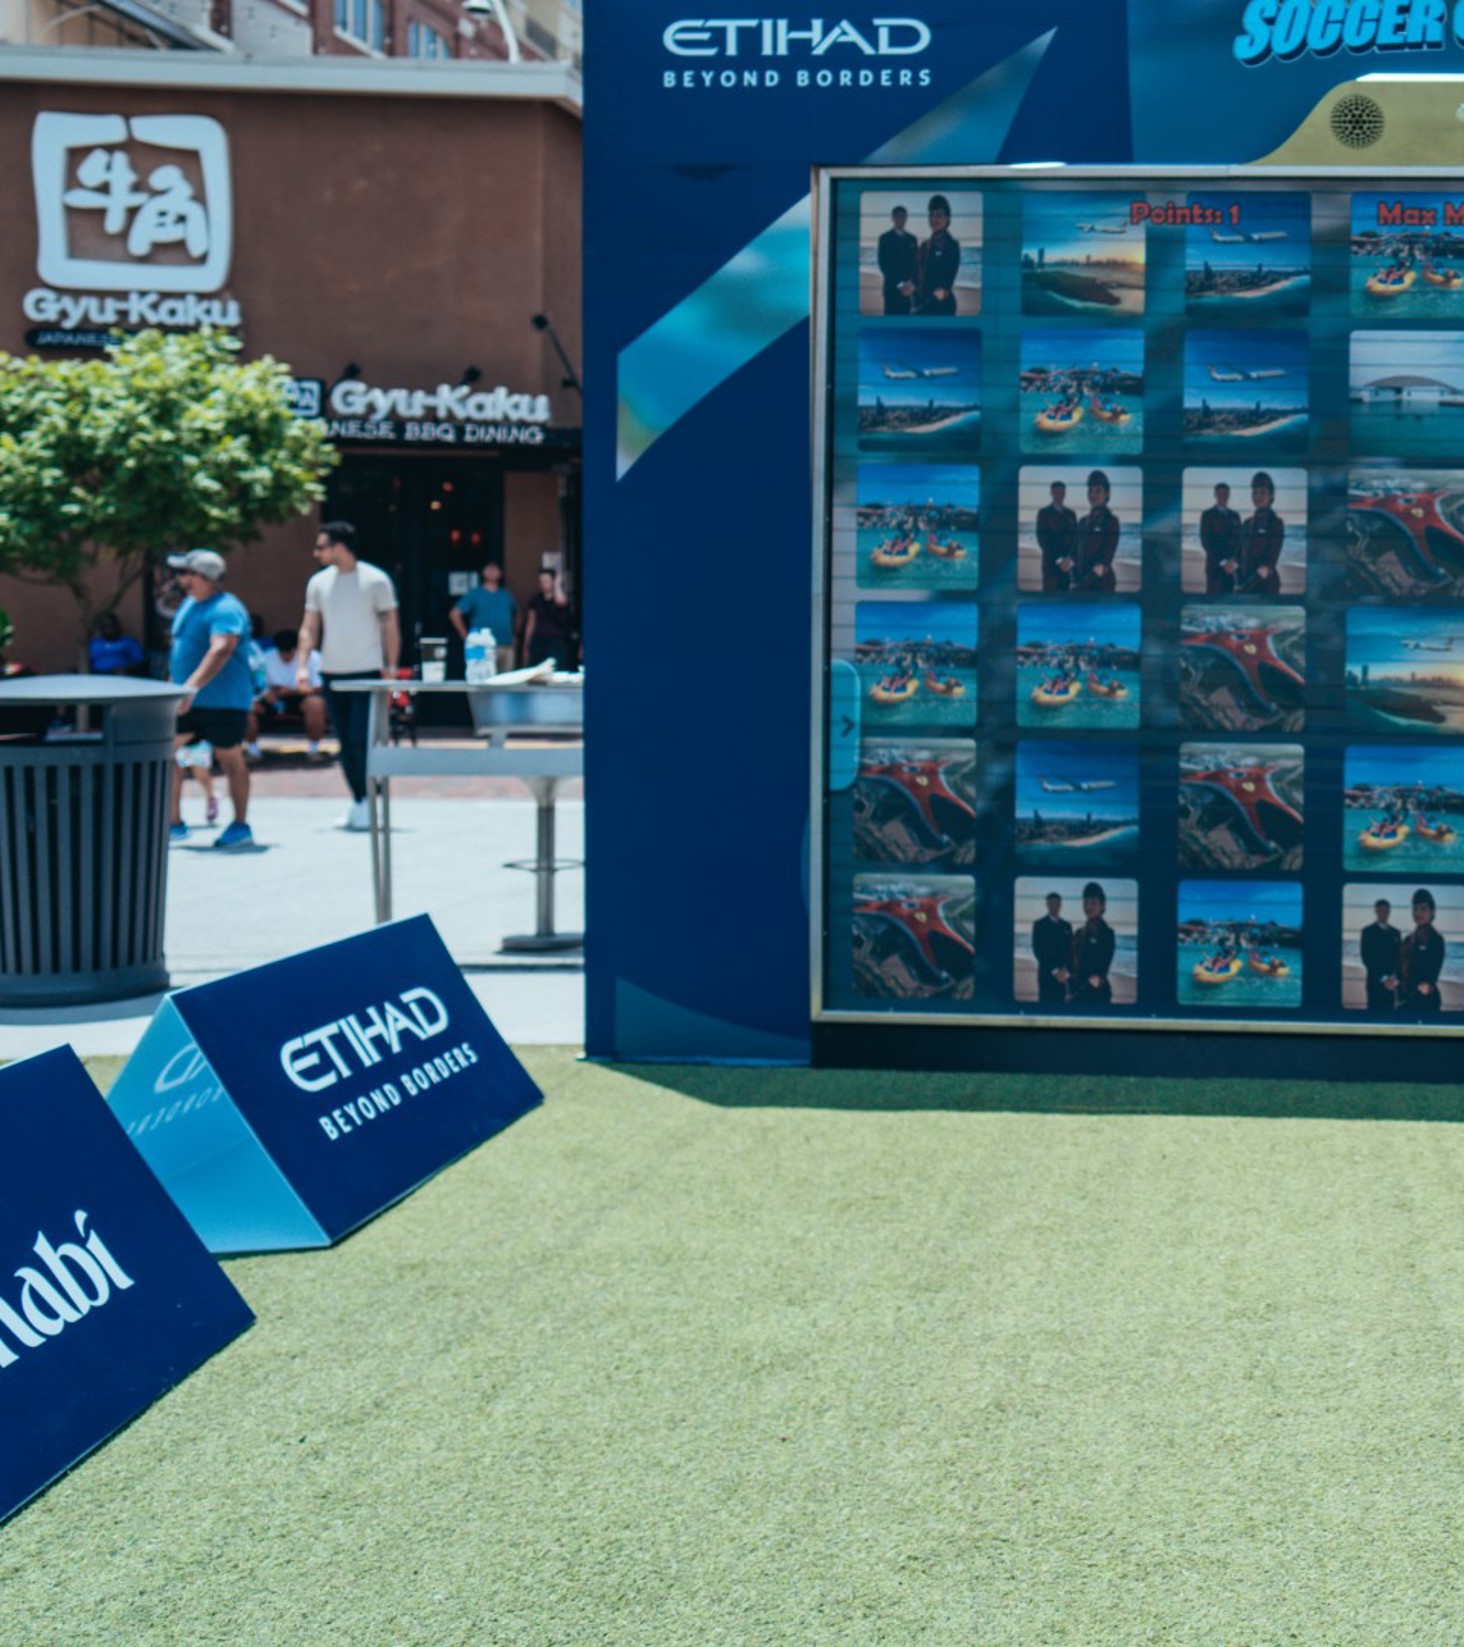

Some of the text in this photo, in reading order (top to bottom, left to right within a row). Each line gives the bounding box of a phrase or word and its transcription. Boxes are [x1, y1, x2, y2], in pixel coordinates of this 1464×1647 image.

[663, 18, 932, 56] ETIHAD
[1233, 0, 1446, 67] SOCCER
[663, 68, 931, 88] BEYOND BORDERS
[63, 147, 209, 259] 牛角
[1130, 202, 1240, 225] Points: 1
[1377, 203, 1438, 226] Max
[23, 287, 241, 329] Gyu-Kaku
[330, 379, 551, 421] Gyu-Kaku
[404, 422, 457, 444] BBQ
[464, 424, 546, 446] DINING
[280, 986, 450, 1093] ETIHAD
[318, 1041, 479, 1141] BEYOND BORDERS
